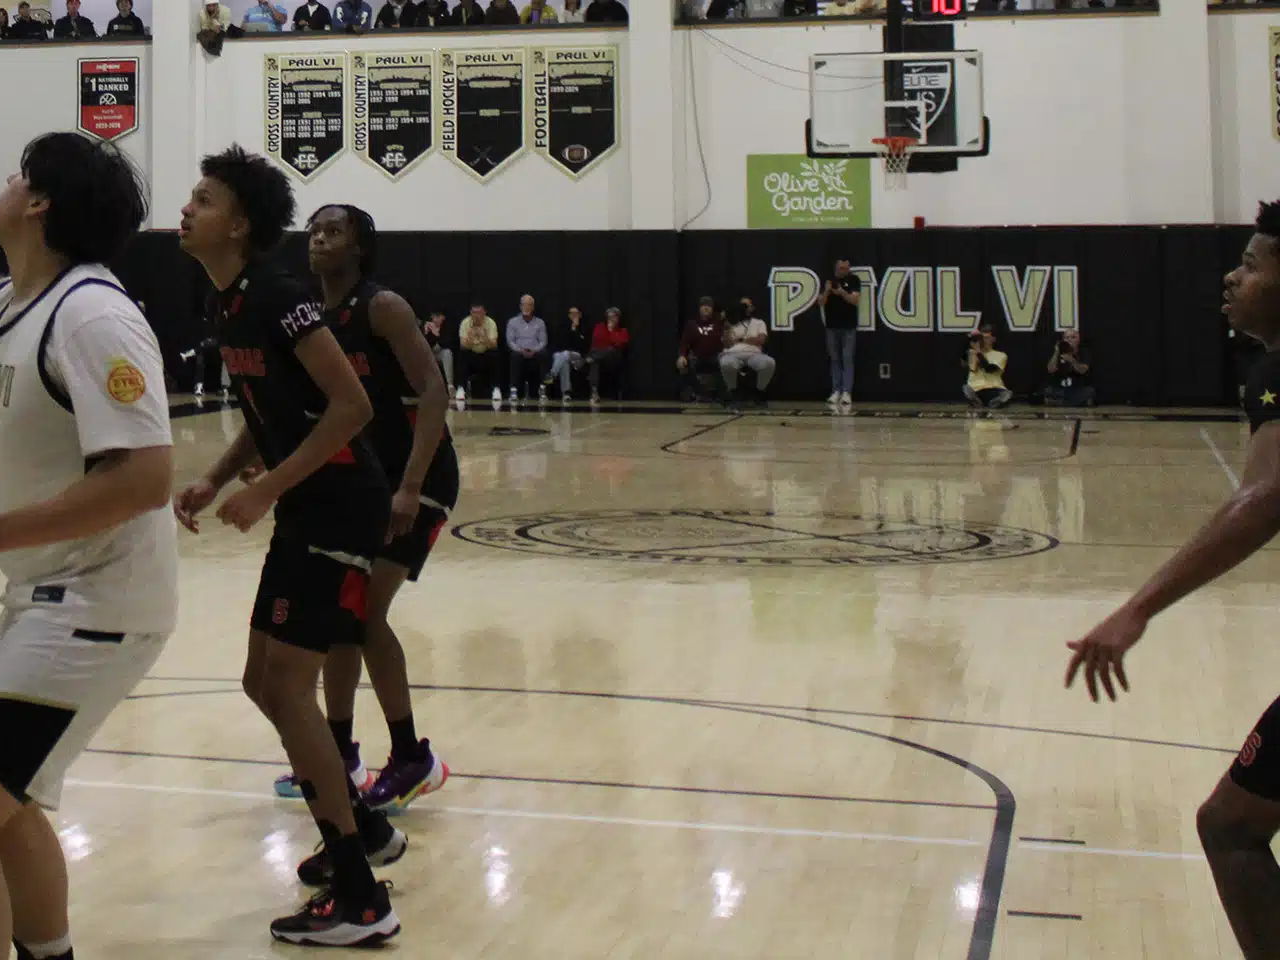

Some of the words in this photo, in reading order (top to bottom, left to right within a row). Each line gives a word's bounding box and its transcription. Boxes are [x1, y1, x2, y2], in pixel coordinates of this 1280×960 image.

[288, 58, 319, 66] PAUL
[323, 58, 335, 66] VI
[376, 56, 407, 64] PAUL
[465, 54, 497, 62] PAUL
[556, 52, 587, 60] PAUL
[593, 51, 606, 59] VI
[268, 76, 280, 120] COUNTRY
[355, 75, 366, 118] COUNTRY
[443, 70, 455, 115] HOCKEY
[534, 70, 547, 148] FOOTBALL
[268, 123, 280, 153] CROSS
[355, 122, 366, 151] CROSS
[443, 120, 455, 151] FIELD
[764, 172, 819, 193] Olive
[772, 191, 853, 216] Garden
[992, 265, 1080, 332] VI
